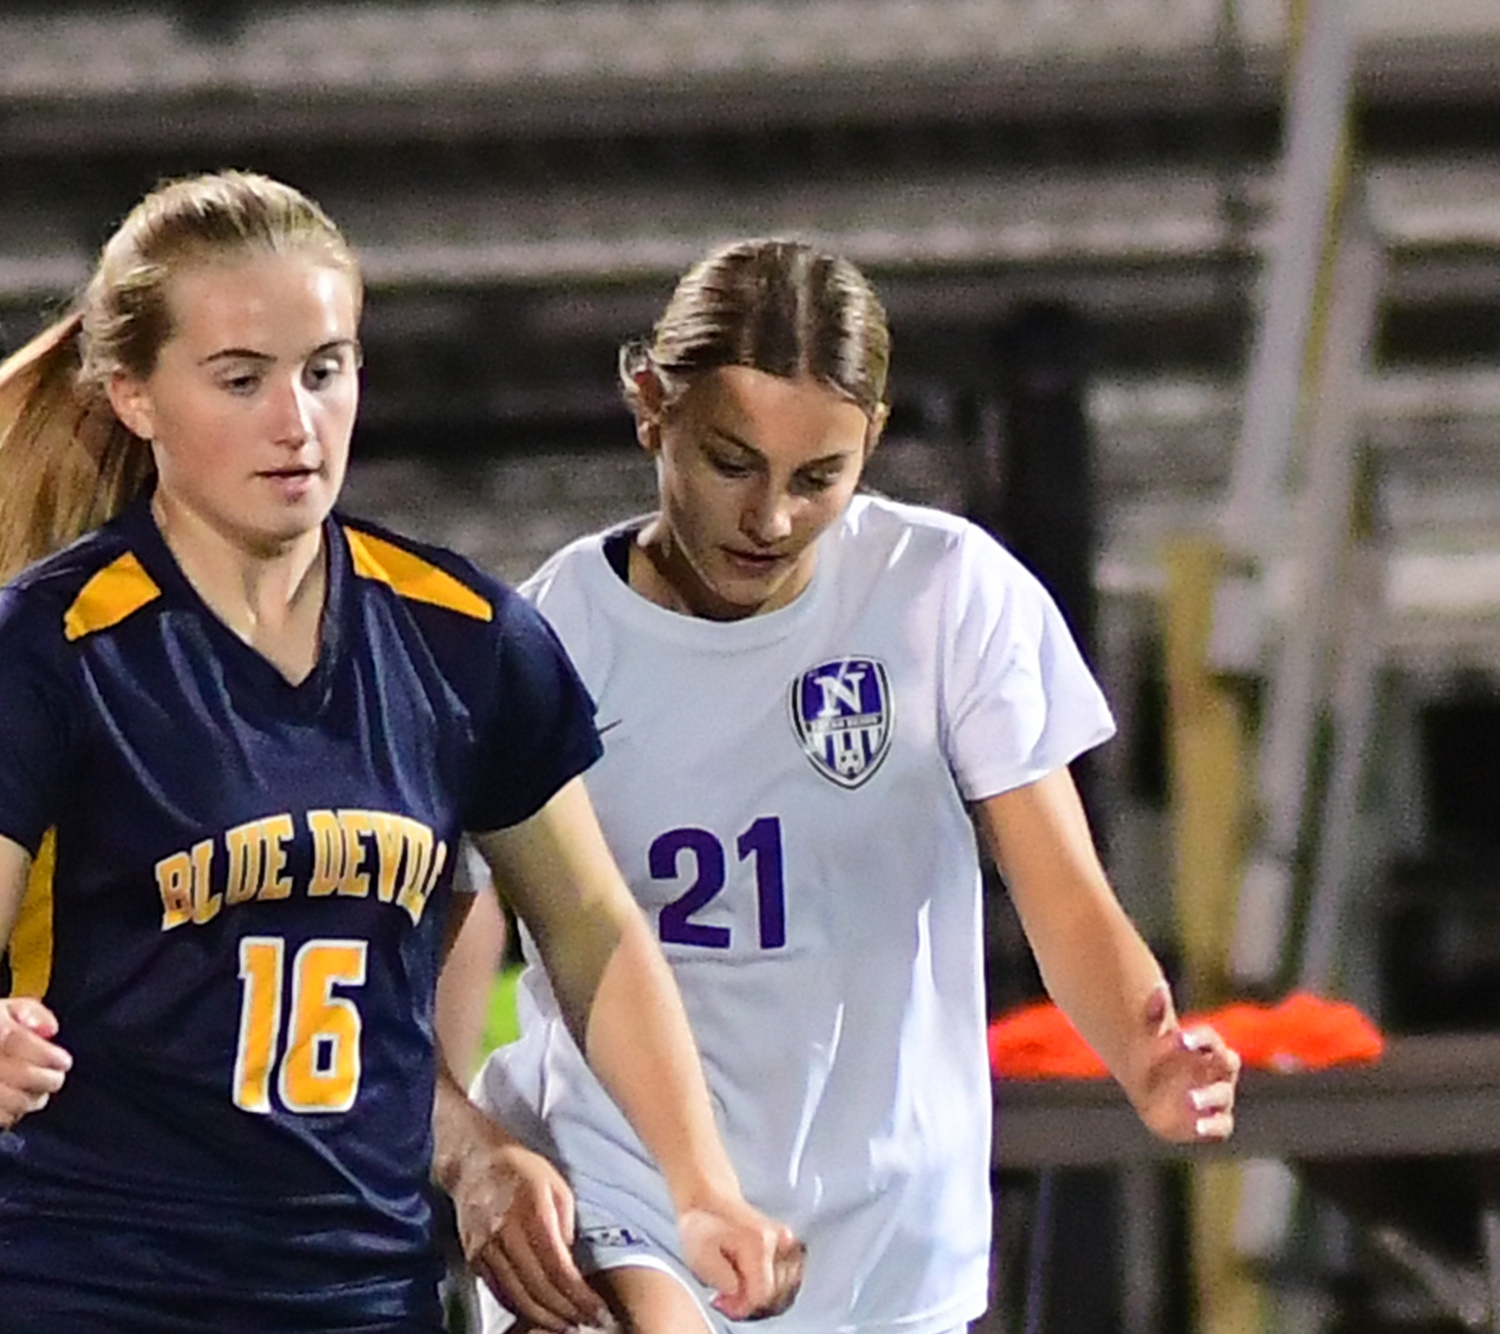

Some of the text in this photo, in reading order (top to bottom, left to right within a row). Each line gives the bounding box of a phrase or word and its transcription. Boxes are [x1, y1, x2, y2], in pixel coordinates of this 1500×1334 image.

[155, 813, 295, 931] BLUE
[648, 816, 786, 949] 21
[232, 936, 368, 1113] 16
